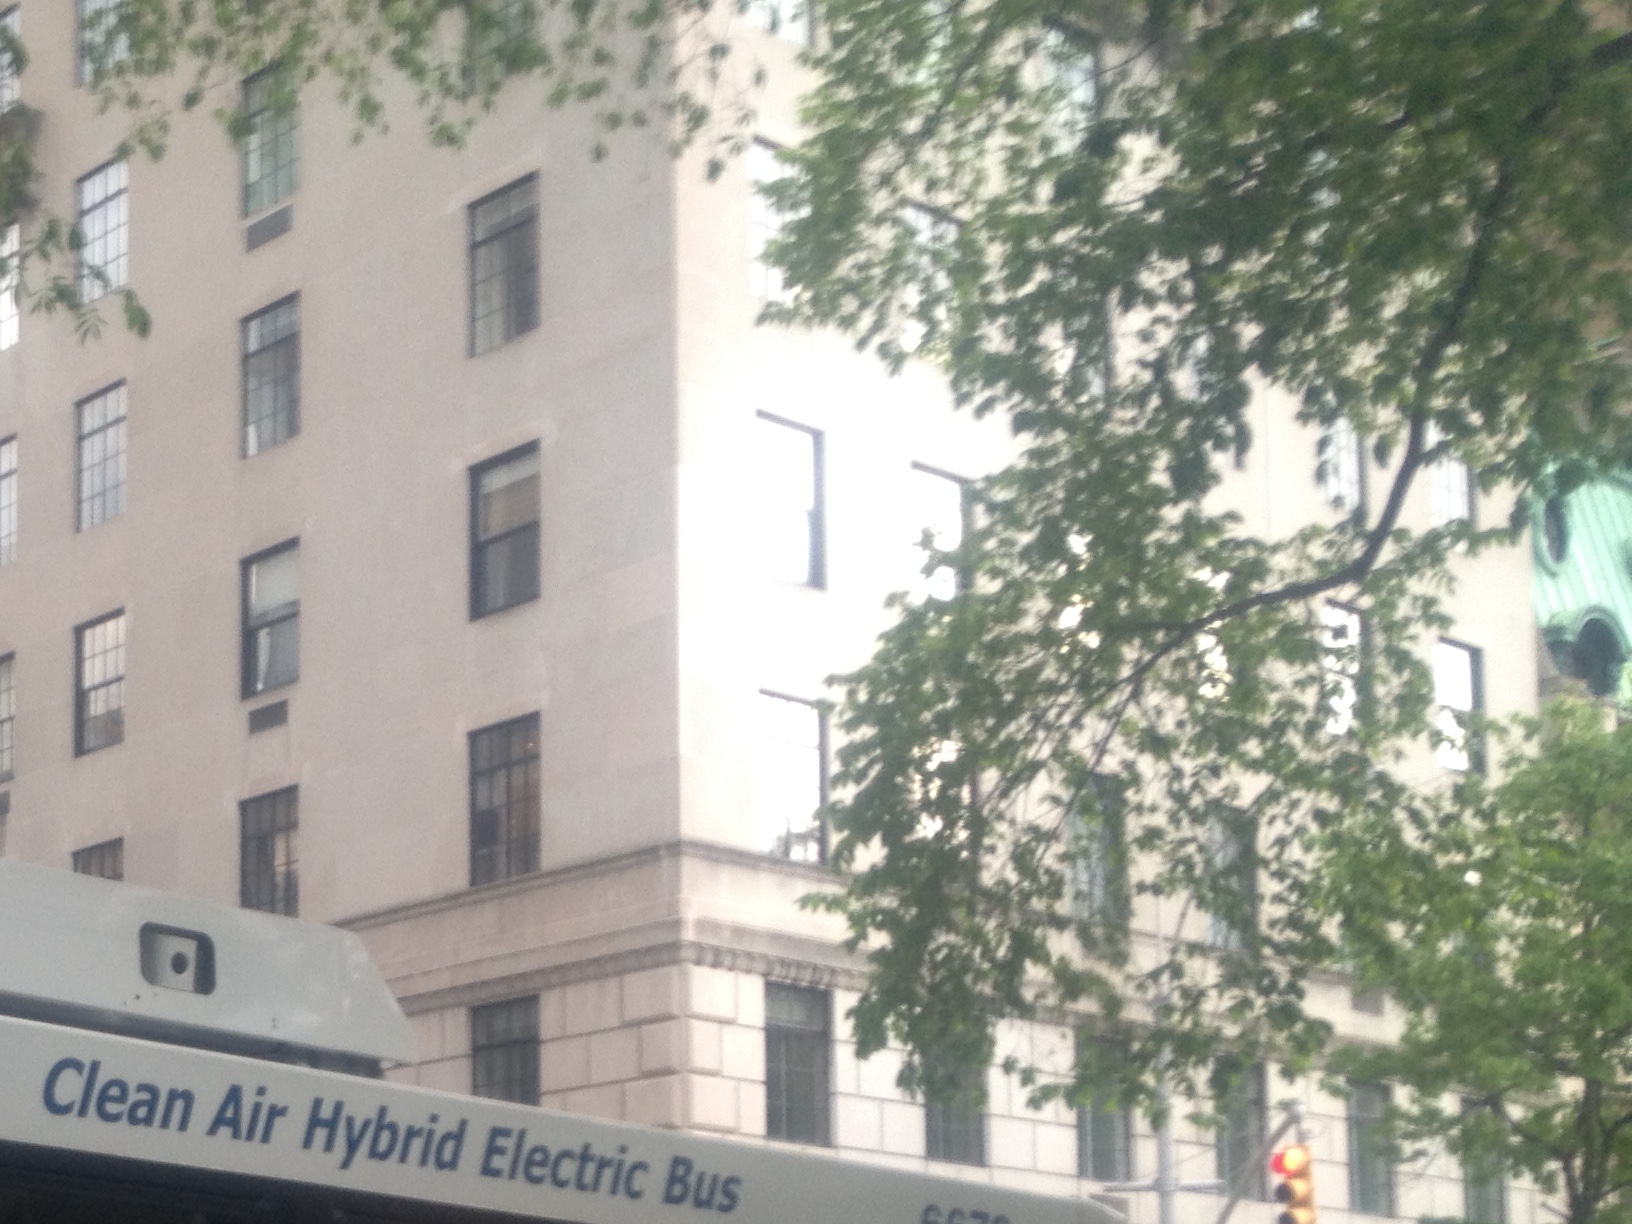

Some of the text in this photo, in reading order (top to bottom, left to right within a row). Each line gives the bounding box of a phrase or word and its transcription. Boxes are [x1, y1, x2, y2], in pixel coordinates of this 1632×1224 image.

[42, 1057, 744, 1213] Clean Air Hybrid Electric Bus
